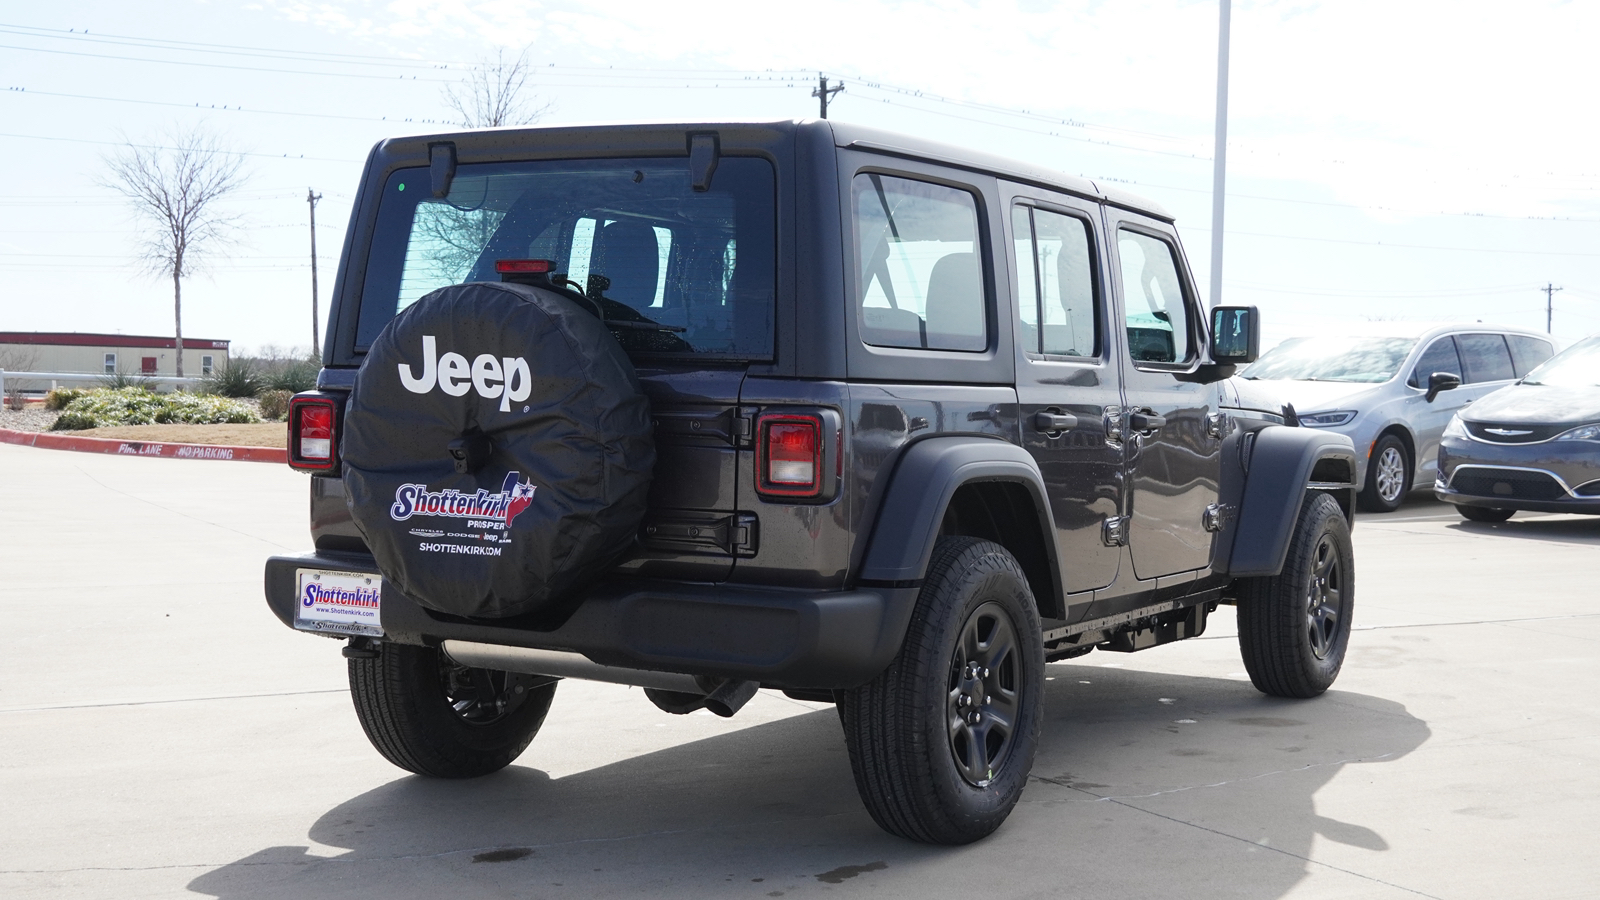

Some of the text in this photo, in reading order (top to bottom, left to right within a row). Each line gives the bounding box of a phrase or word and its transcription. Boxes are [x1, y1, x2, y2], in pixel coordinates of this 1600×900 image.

[398, 335, 532, 413] Jeep
[139, 445, 163, 455] LANE
[178, 446, 193, 457] NO
[192, 448, 233, 460] PARKING
[391, 483, 511, 521] Shottenkirk
[483, 532, 498, 543] Jeep
[419, 542, 501, 556] SHOTTENKIRK.COM
[303, 584, 379, 607] Shottenkirk
[316, 607, 374, 617] www.Shottenkirk.com
